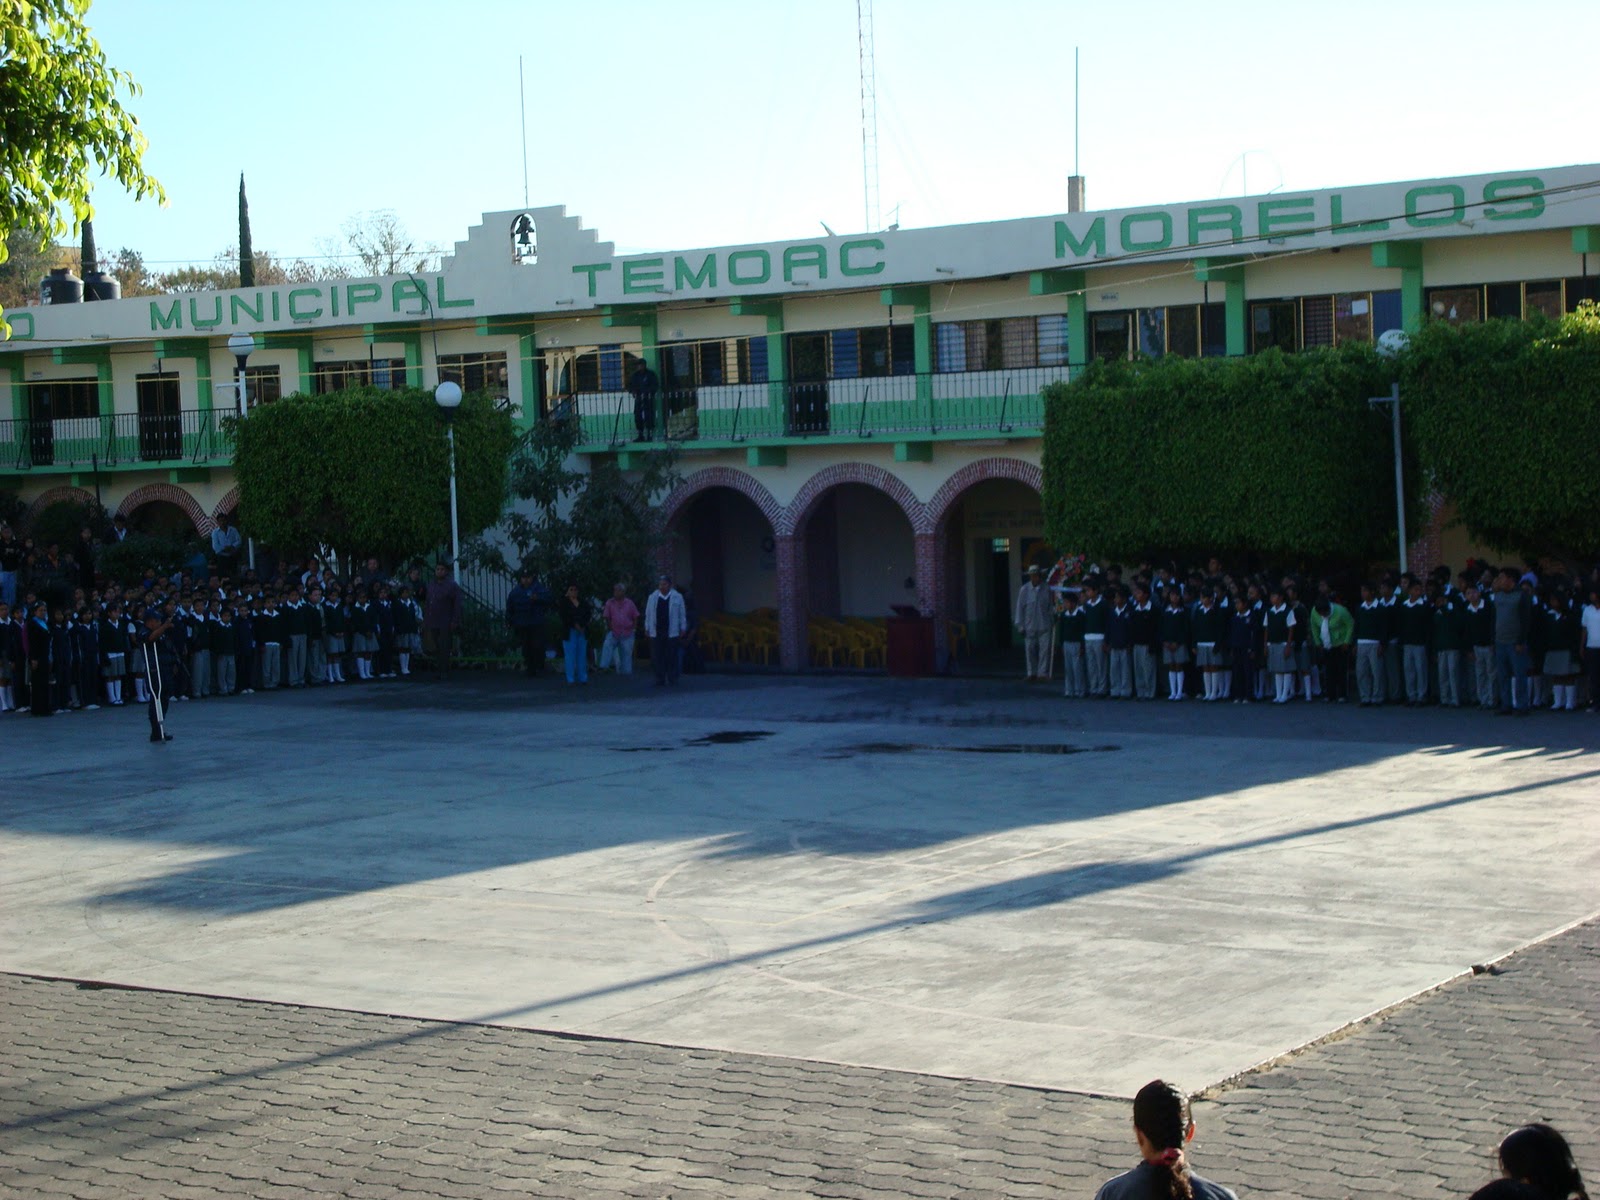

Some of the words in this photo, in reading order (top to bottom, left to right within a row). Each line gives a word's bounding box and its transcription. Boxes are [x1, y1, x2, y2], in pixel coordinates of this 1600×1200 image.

[150, 276, 475, 331] MUNICIPAL
[572, 238, 886, 298] TEMOAC
[1055, 176, 1546, 258] MORELOS
